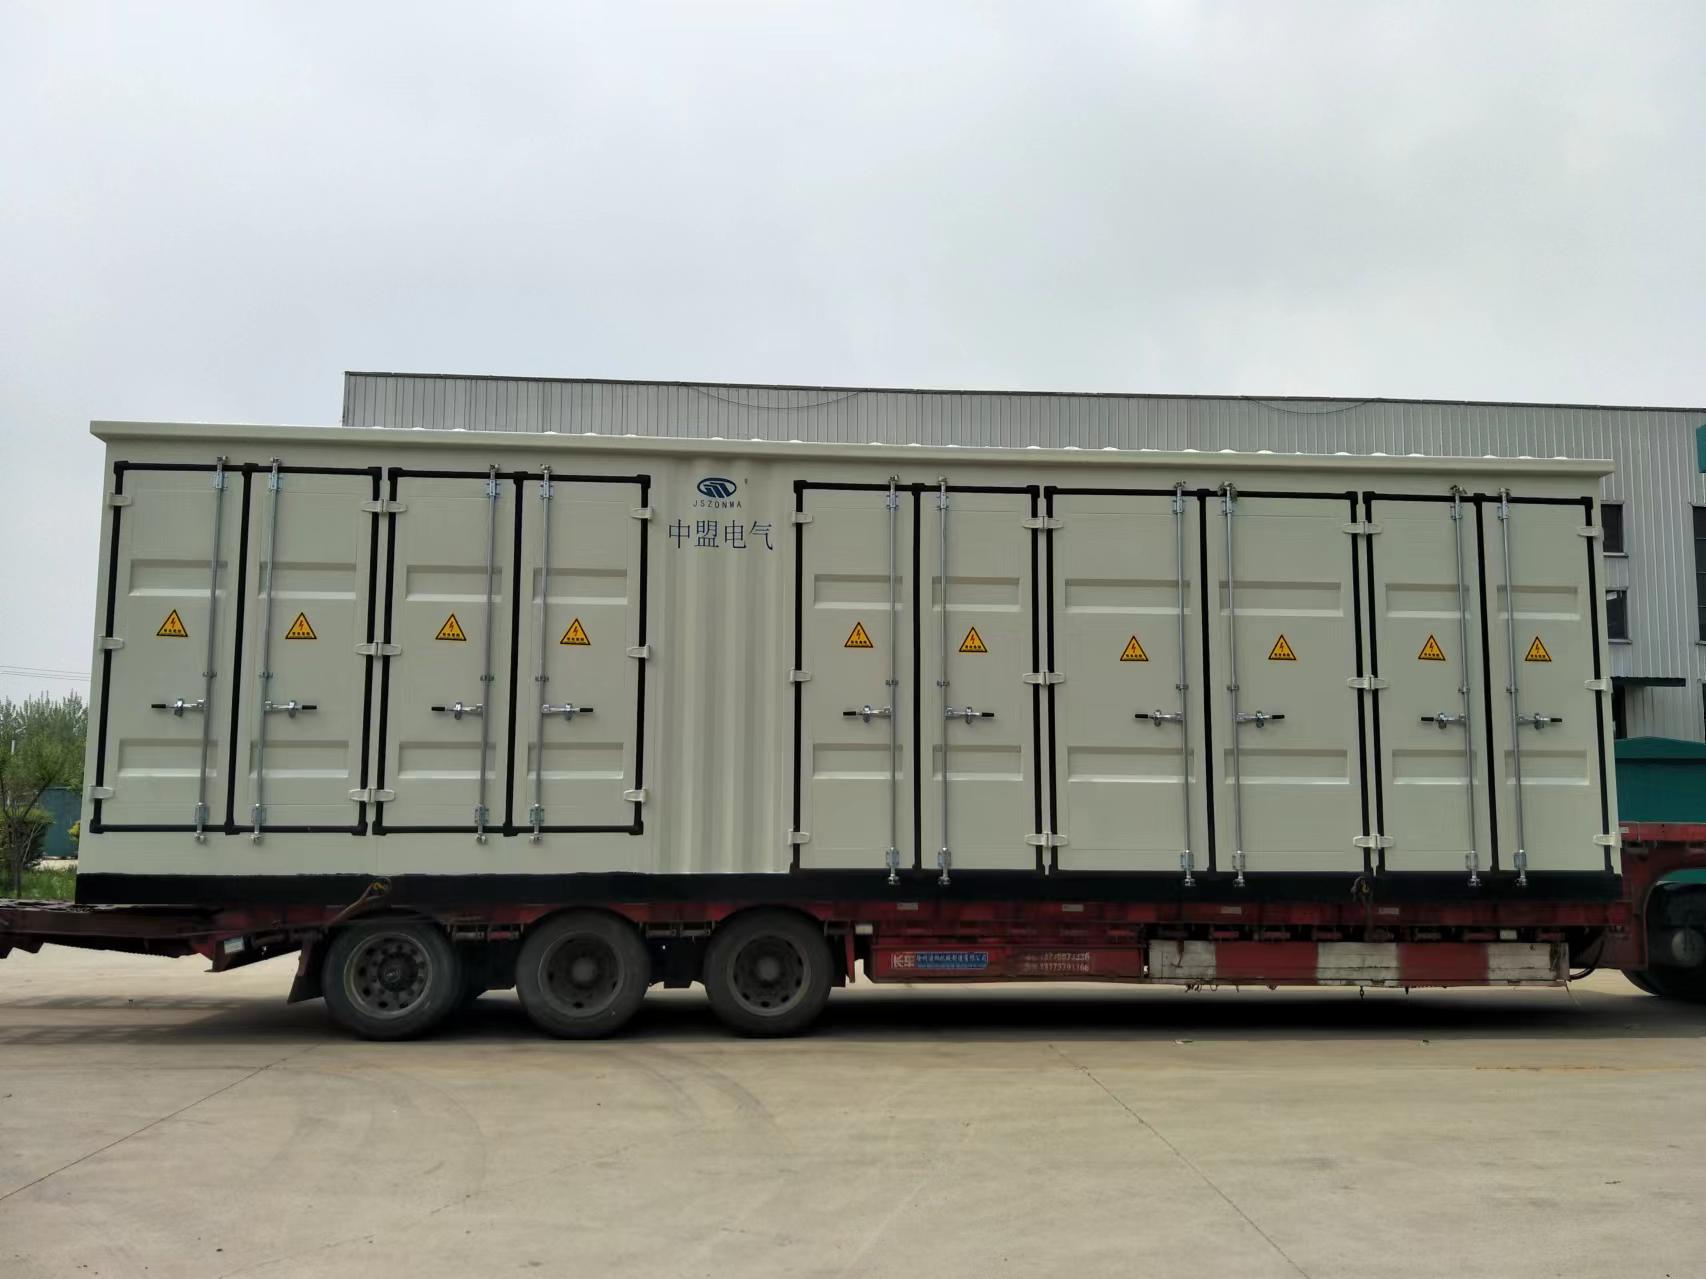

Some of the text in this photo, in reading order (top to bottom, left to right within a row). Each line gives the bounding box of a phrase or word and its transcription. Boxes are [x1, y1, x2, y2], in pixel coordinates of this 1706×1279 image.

[693, 500, 742, 509] JSZONMA
[668, 519, 773, 551] 中盟电气
